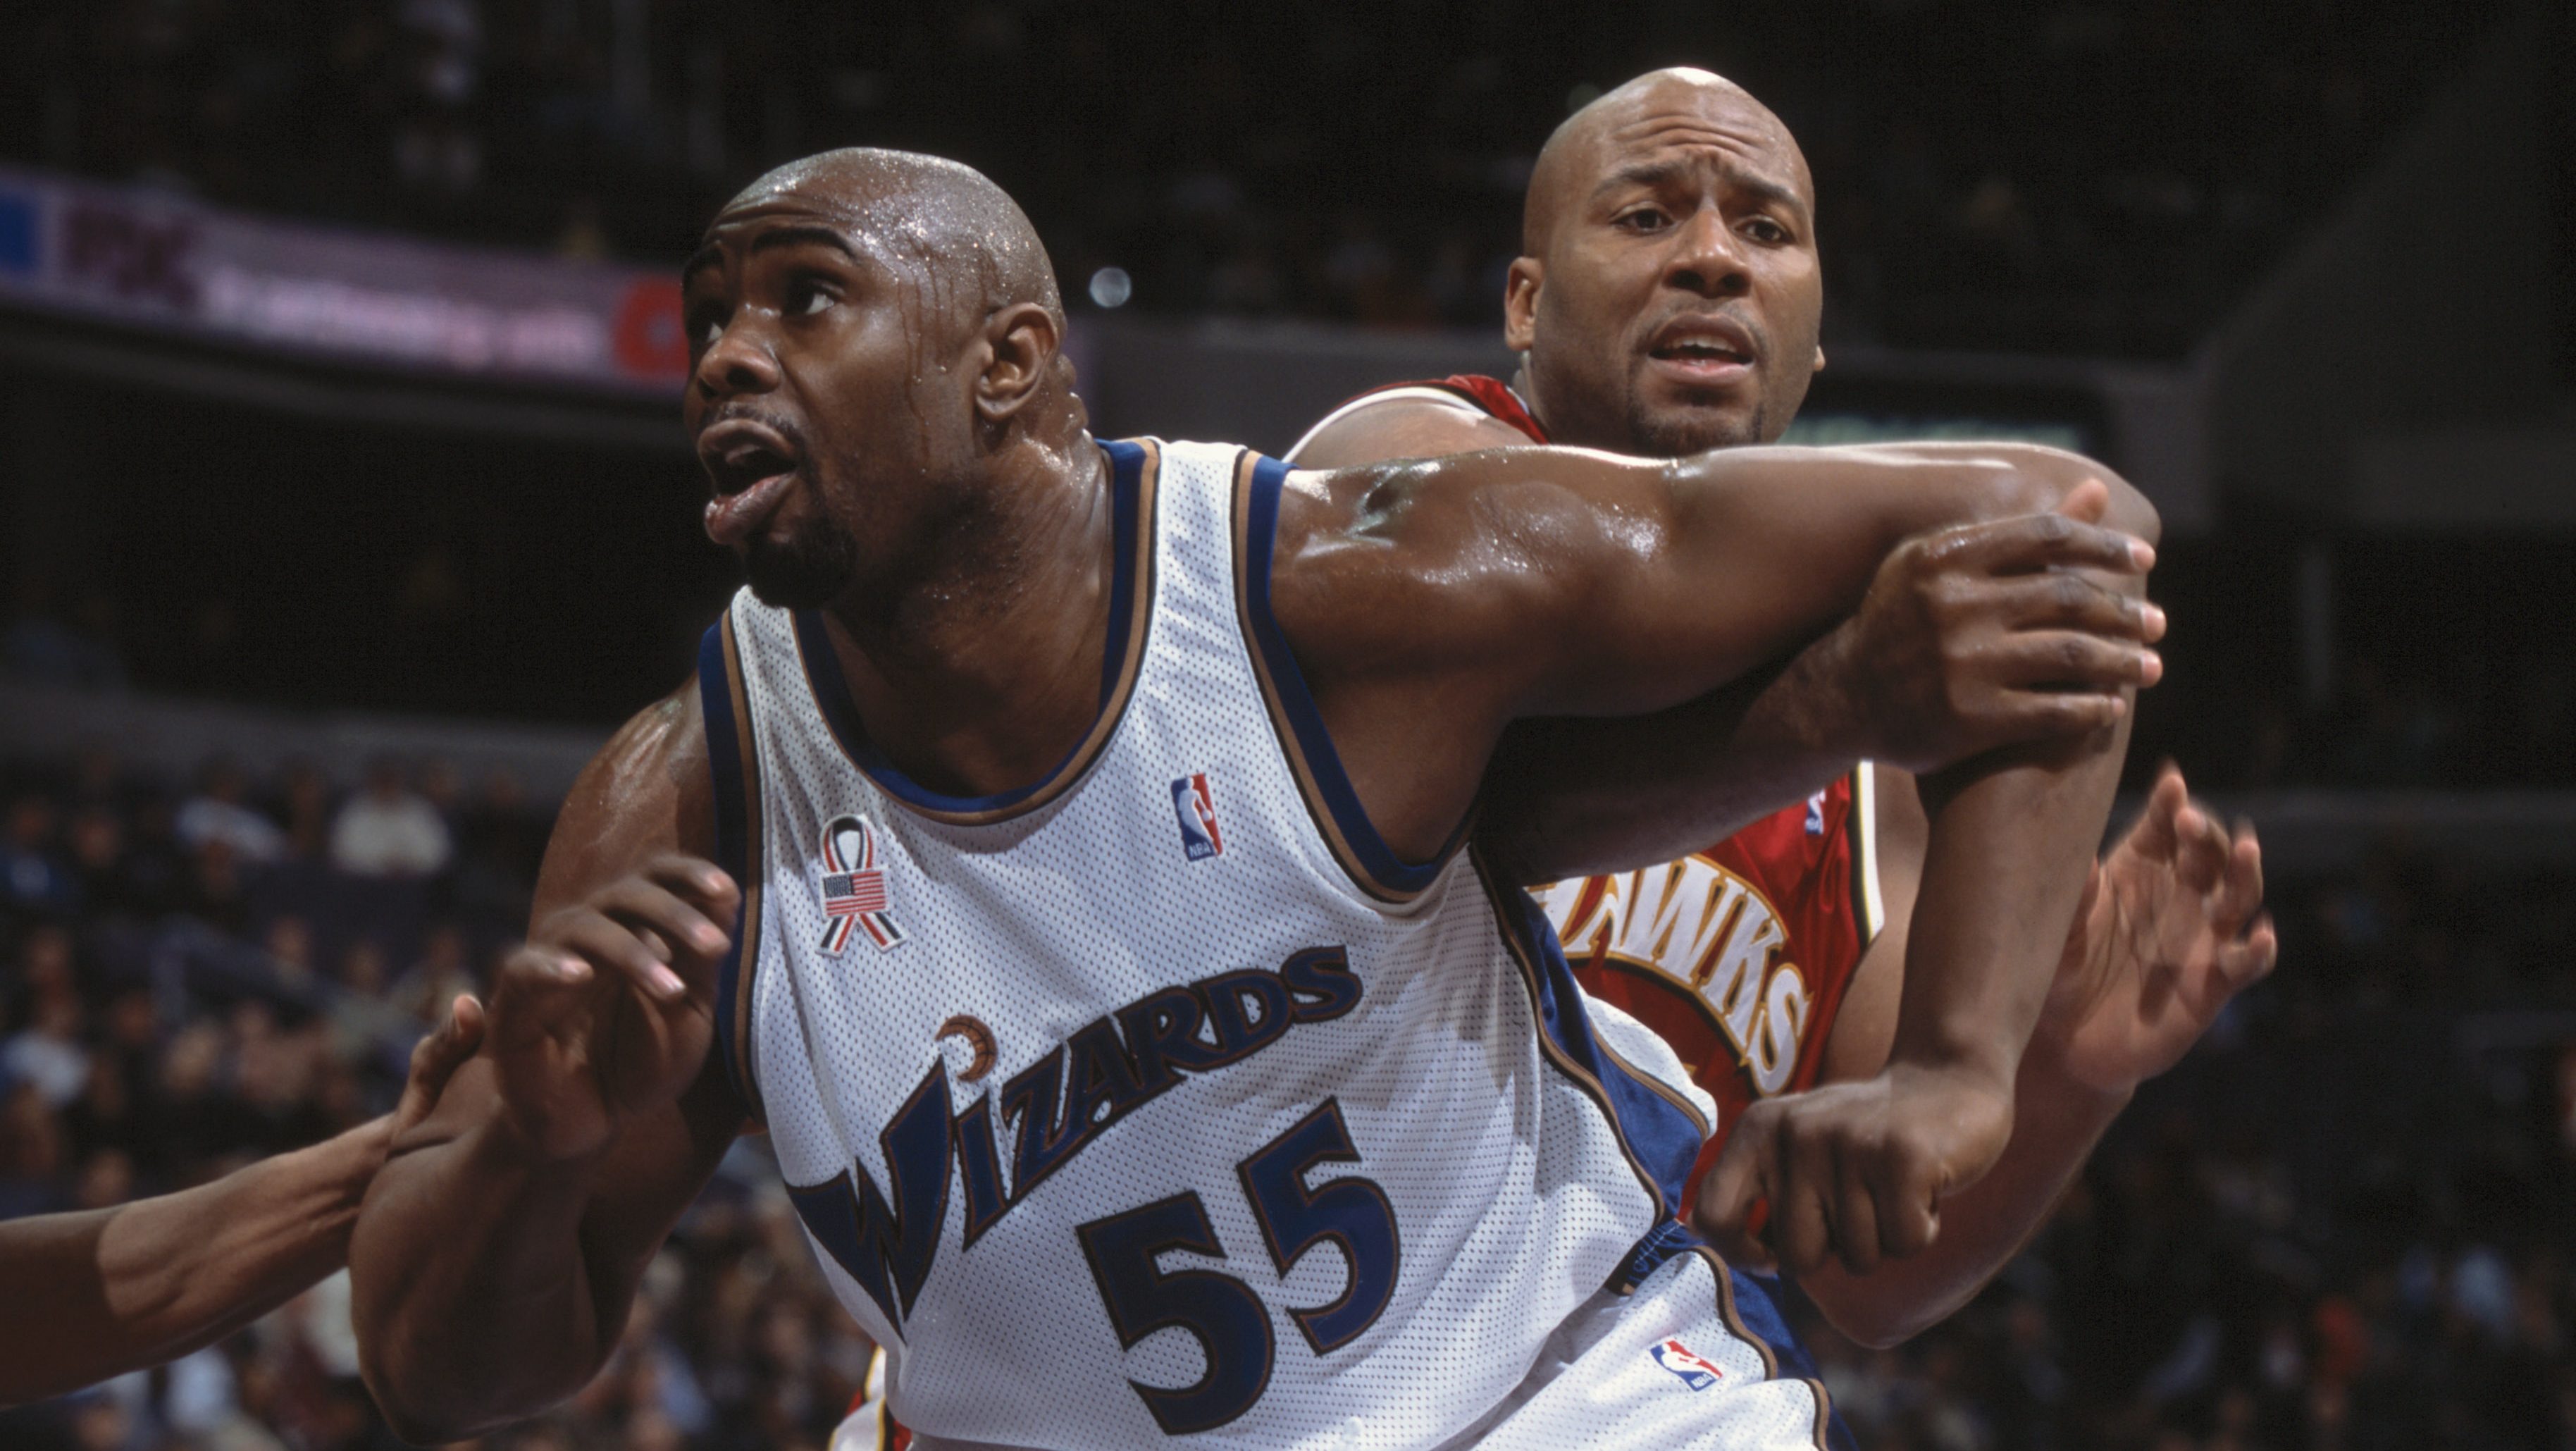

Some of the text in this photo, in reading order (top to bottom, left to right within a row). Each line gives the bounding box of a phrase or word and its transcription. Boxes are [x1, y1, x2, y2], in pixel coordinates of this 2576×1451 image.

[1189, 841, 1212, 858] NBA
[784, 945, 1364, 1346] WIZARDS
[1076, 1096, 1401, 1435] 55
[1691, 1372, 1713, 1389] NBA
